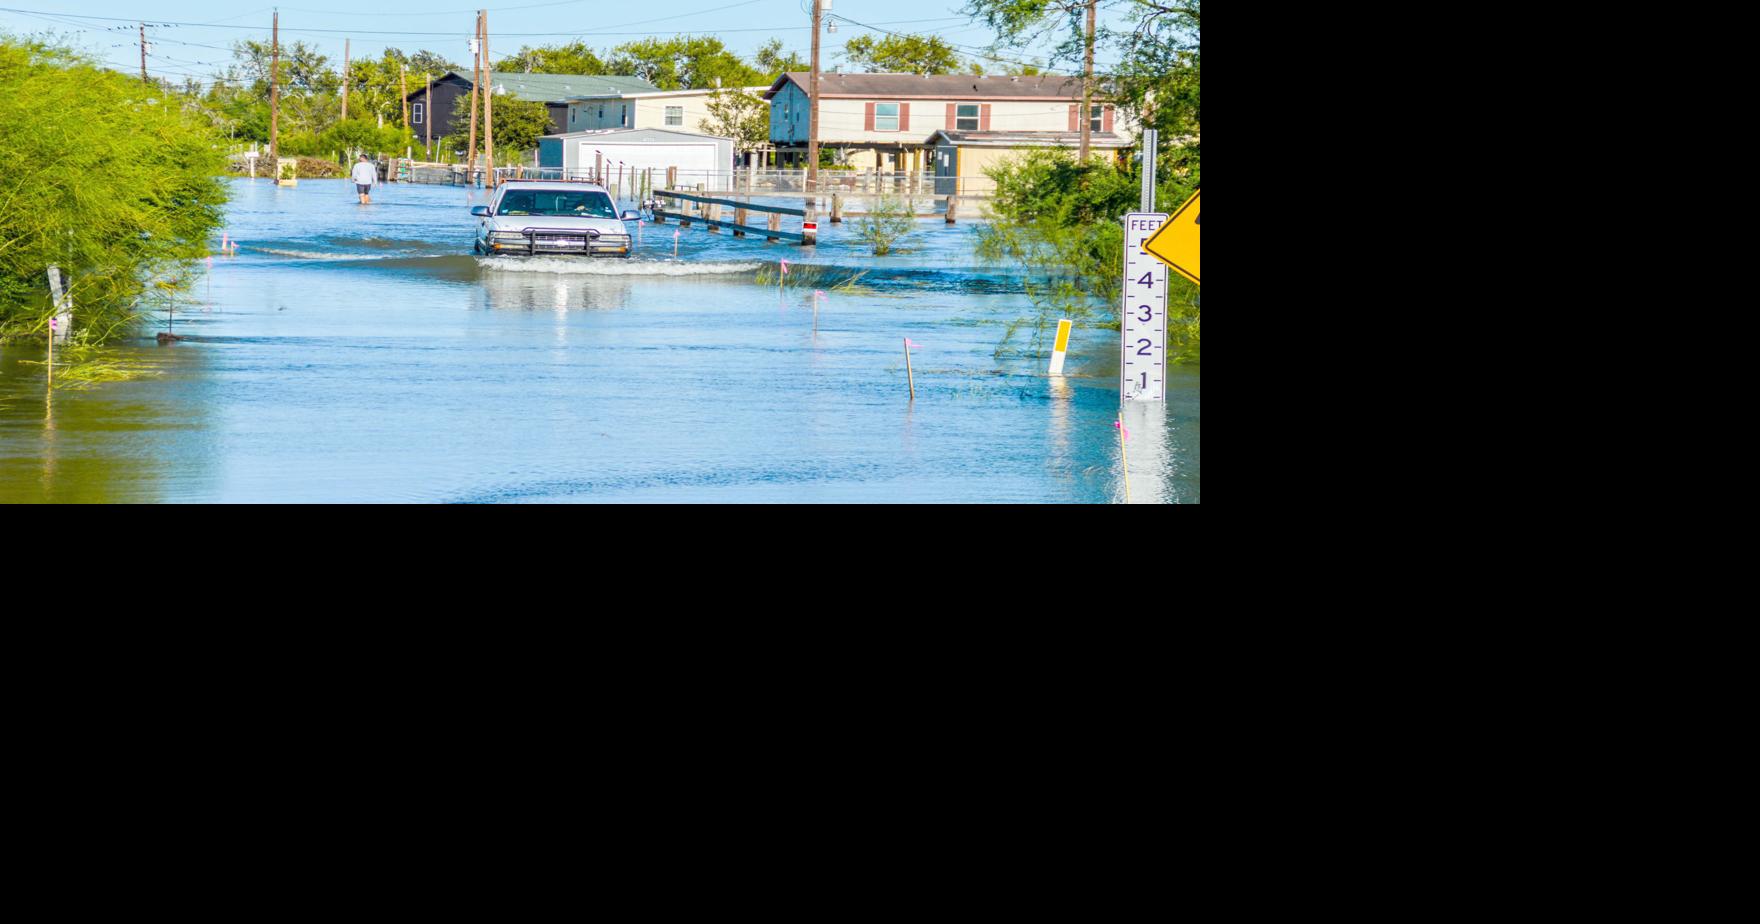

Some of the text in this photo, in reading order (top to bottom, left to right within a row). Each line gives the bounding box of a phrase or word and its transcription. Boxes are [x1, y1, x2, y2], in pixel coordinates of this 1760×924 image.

[1131, 219, 1164, 231] FEET
[1137, 271, 1154, 289] 4
[1137, 304, 1152, 322] 3
[1136, 338, 1152, 356] 2
[1140, 371, 1147, 389] 1
